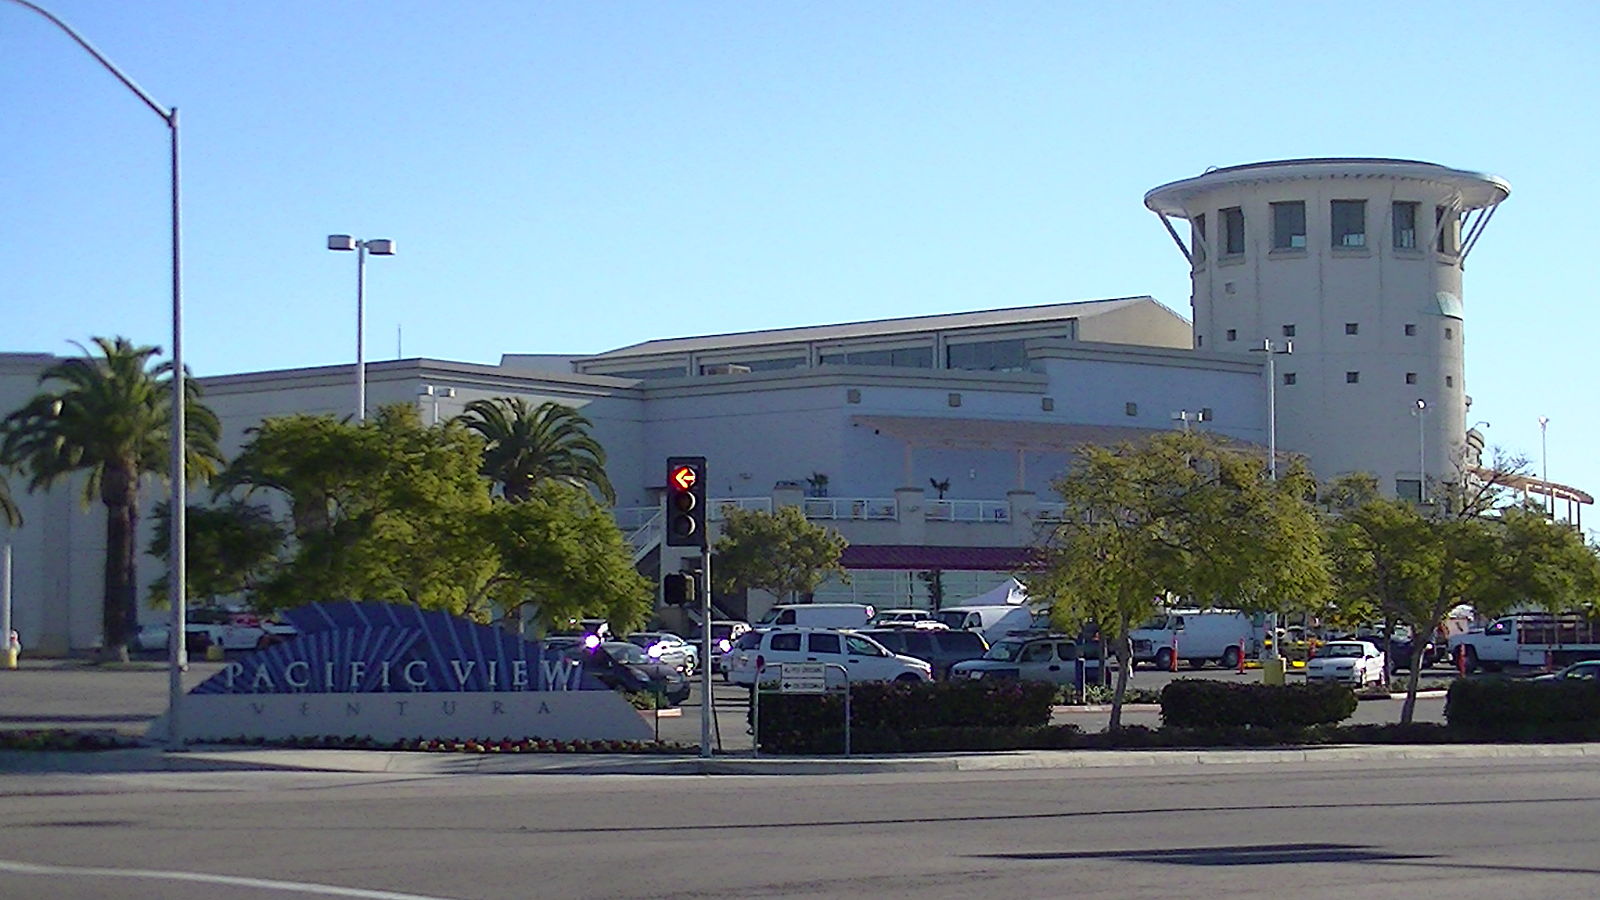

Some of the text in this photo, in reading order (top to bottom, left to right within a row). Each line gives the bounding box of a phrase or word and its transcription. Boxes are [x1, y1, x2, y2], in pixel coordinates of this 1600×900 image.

[225, 660, 575, 689] PACIFIC VIEW
[252, 701, 551, 716] VENTURA
